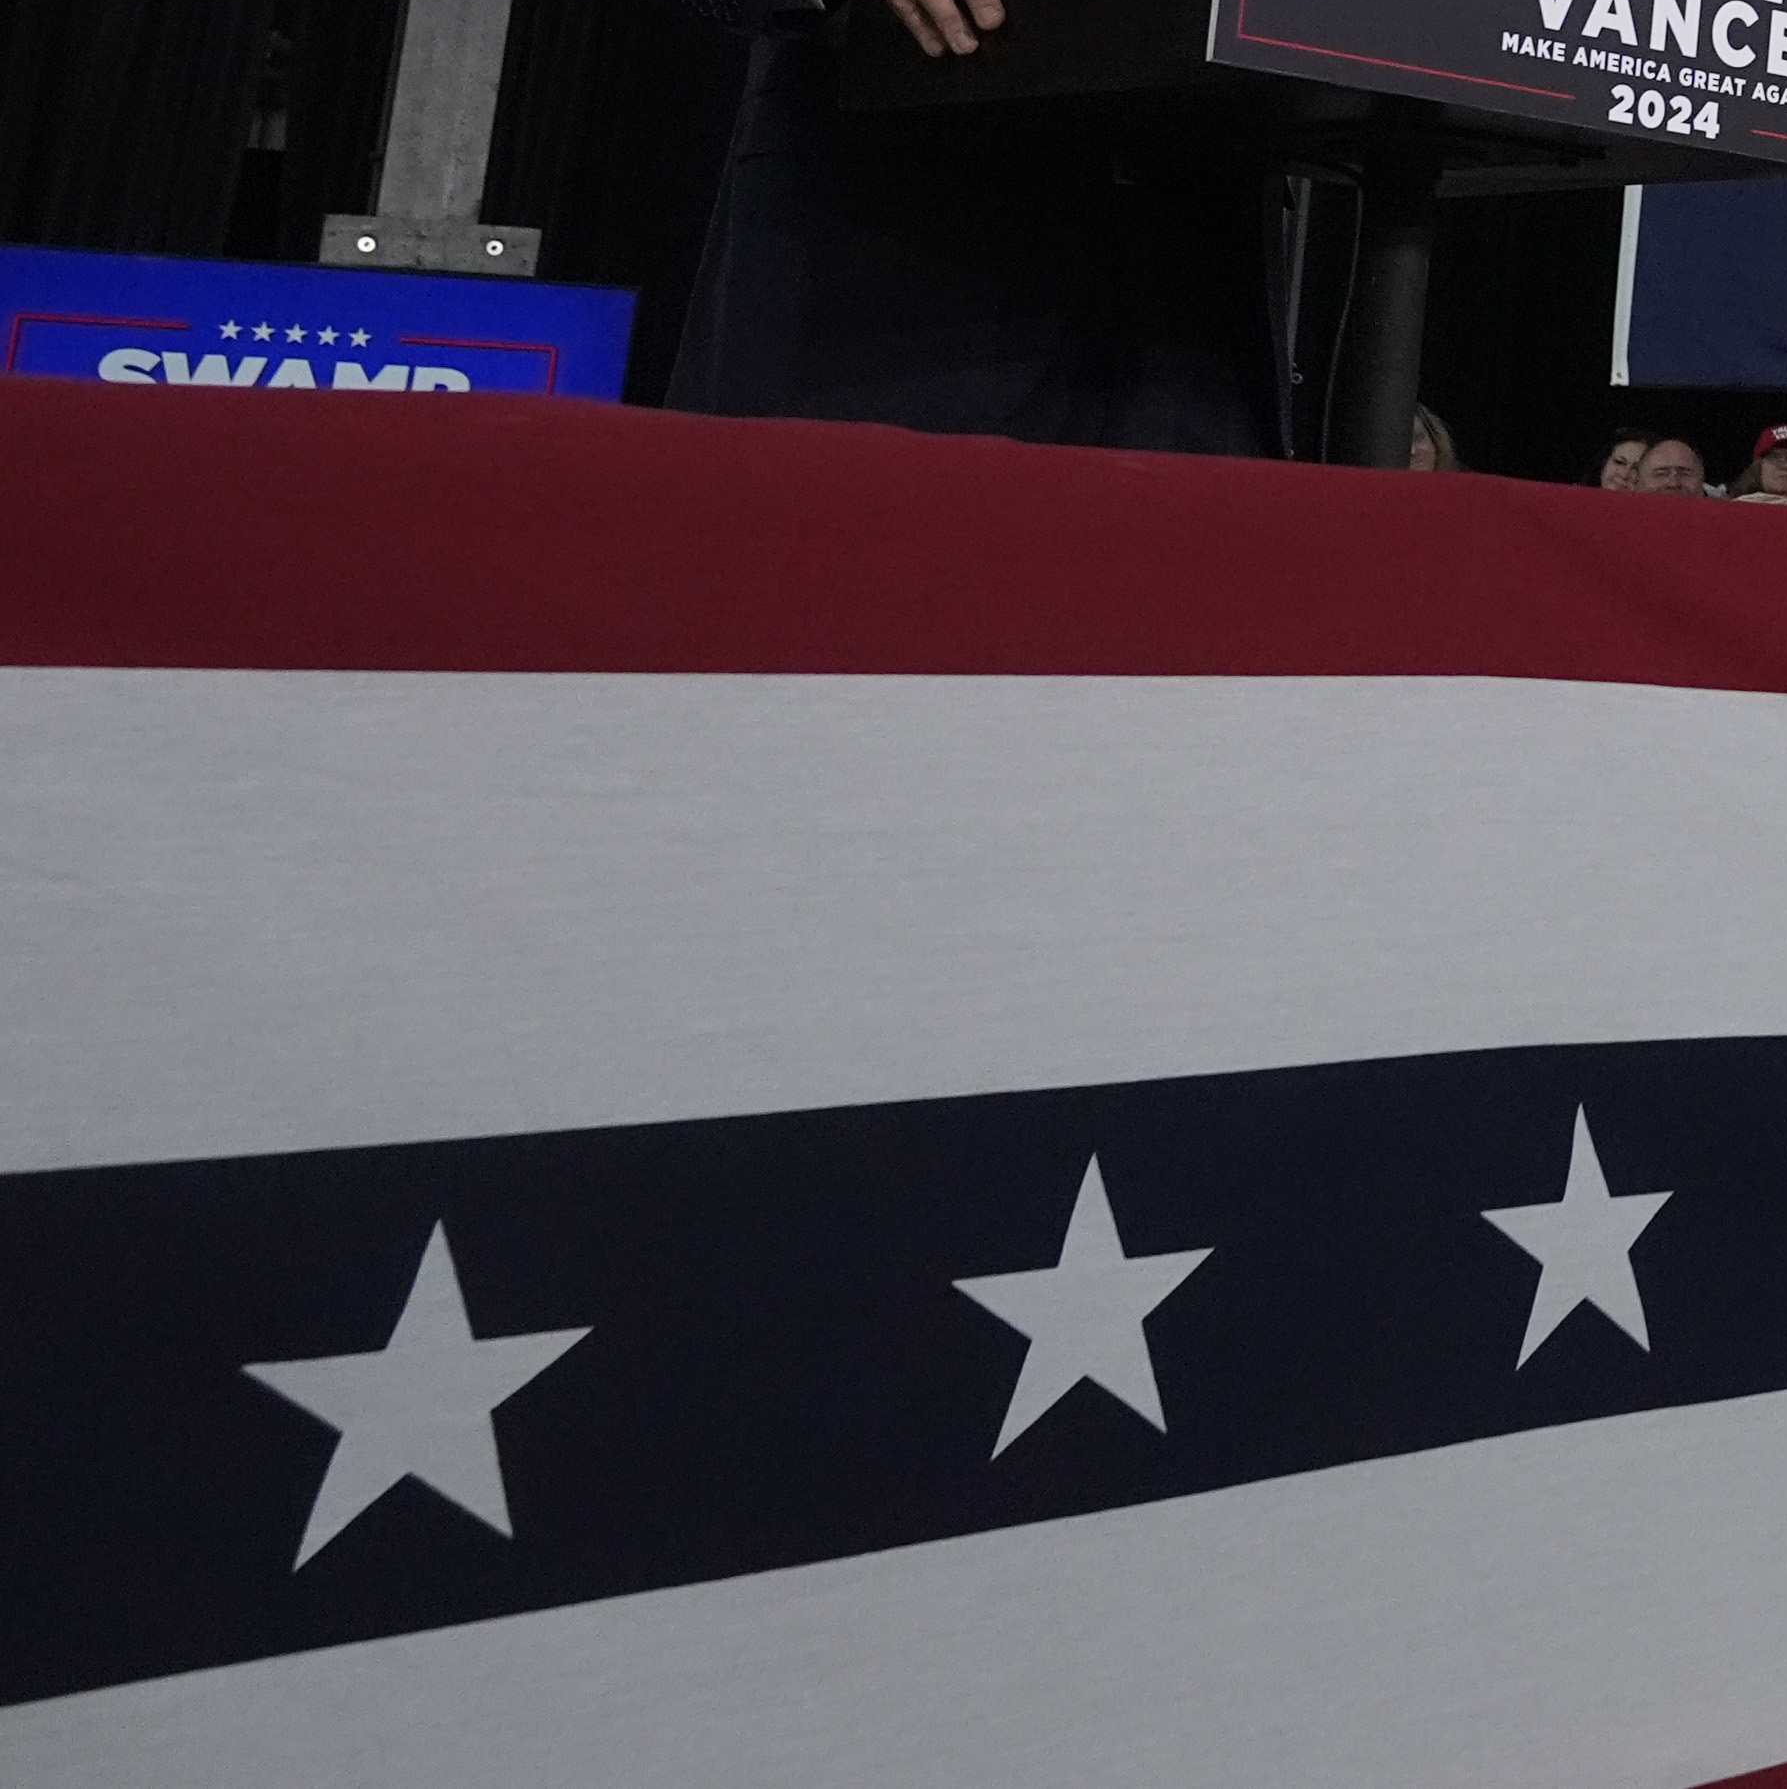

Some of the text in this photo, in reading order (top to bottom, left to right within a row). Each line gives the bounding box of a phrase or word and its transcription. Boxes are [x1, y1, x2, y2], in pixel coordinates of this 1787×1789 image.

[1501, 31, 1567, 62] MAKE
[1572, 46, 1672, 83] AMERICA
[1678, 67, 1747, 97] GREAT
[1608, 84, 1721, 140] 2024
